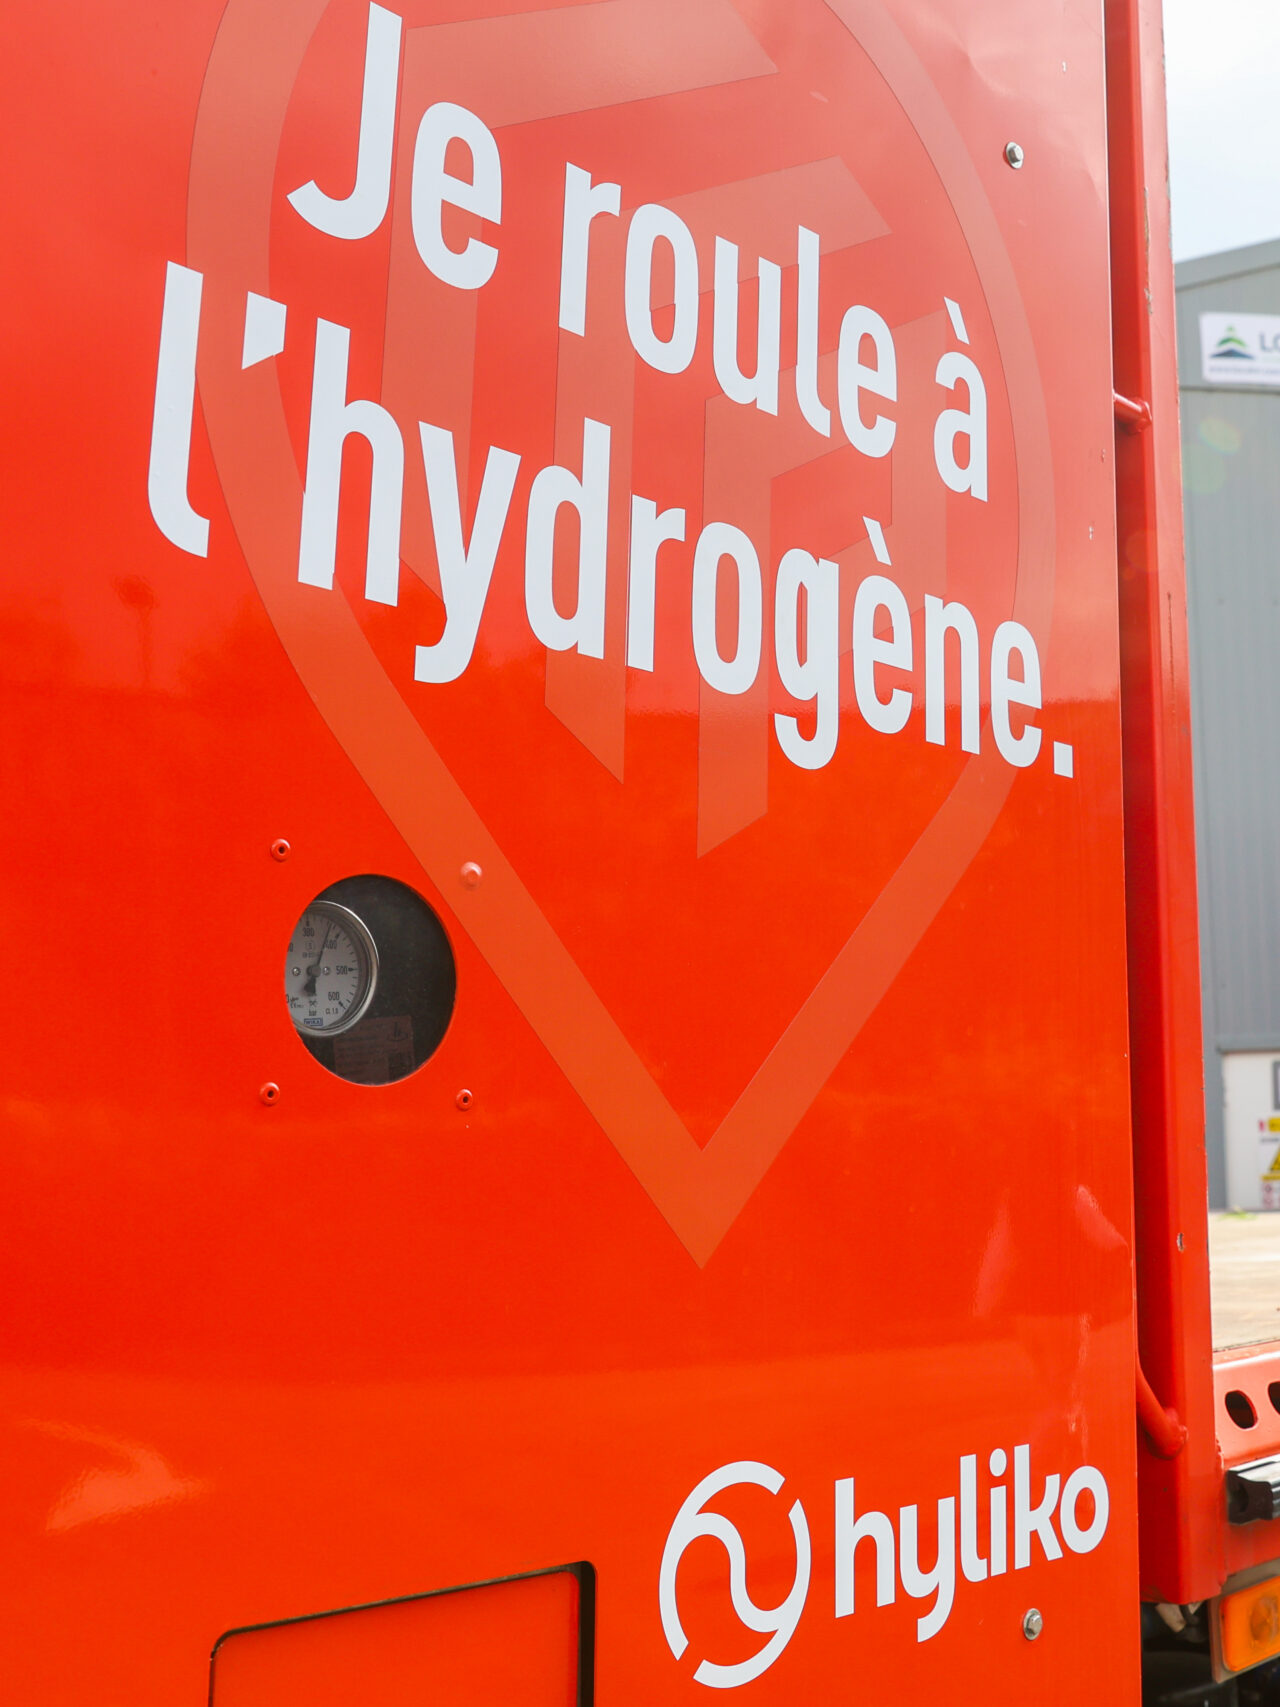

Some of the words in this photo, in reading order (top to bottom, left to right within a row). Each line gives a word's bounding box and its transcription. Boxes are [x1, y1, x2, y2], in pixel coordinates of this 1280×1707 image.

[287, 1, 503, 290] Je
[559, 162, 898, 459] roule
[933, 297, 989, 503] à
[328, 991, 340, 1001] 600
[336, 965, 348, 975] 500
[834, 1443, 1110, 1643] hyliko
